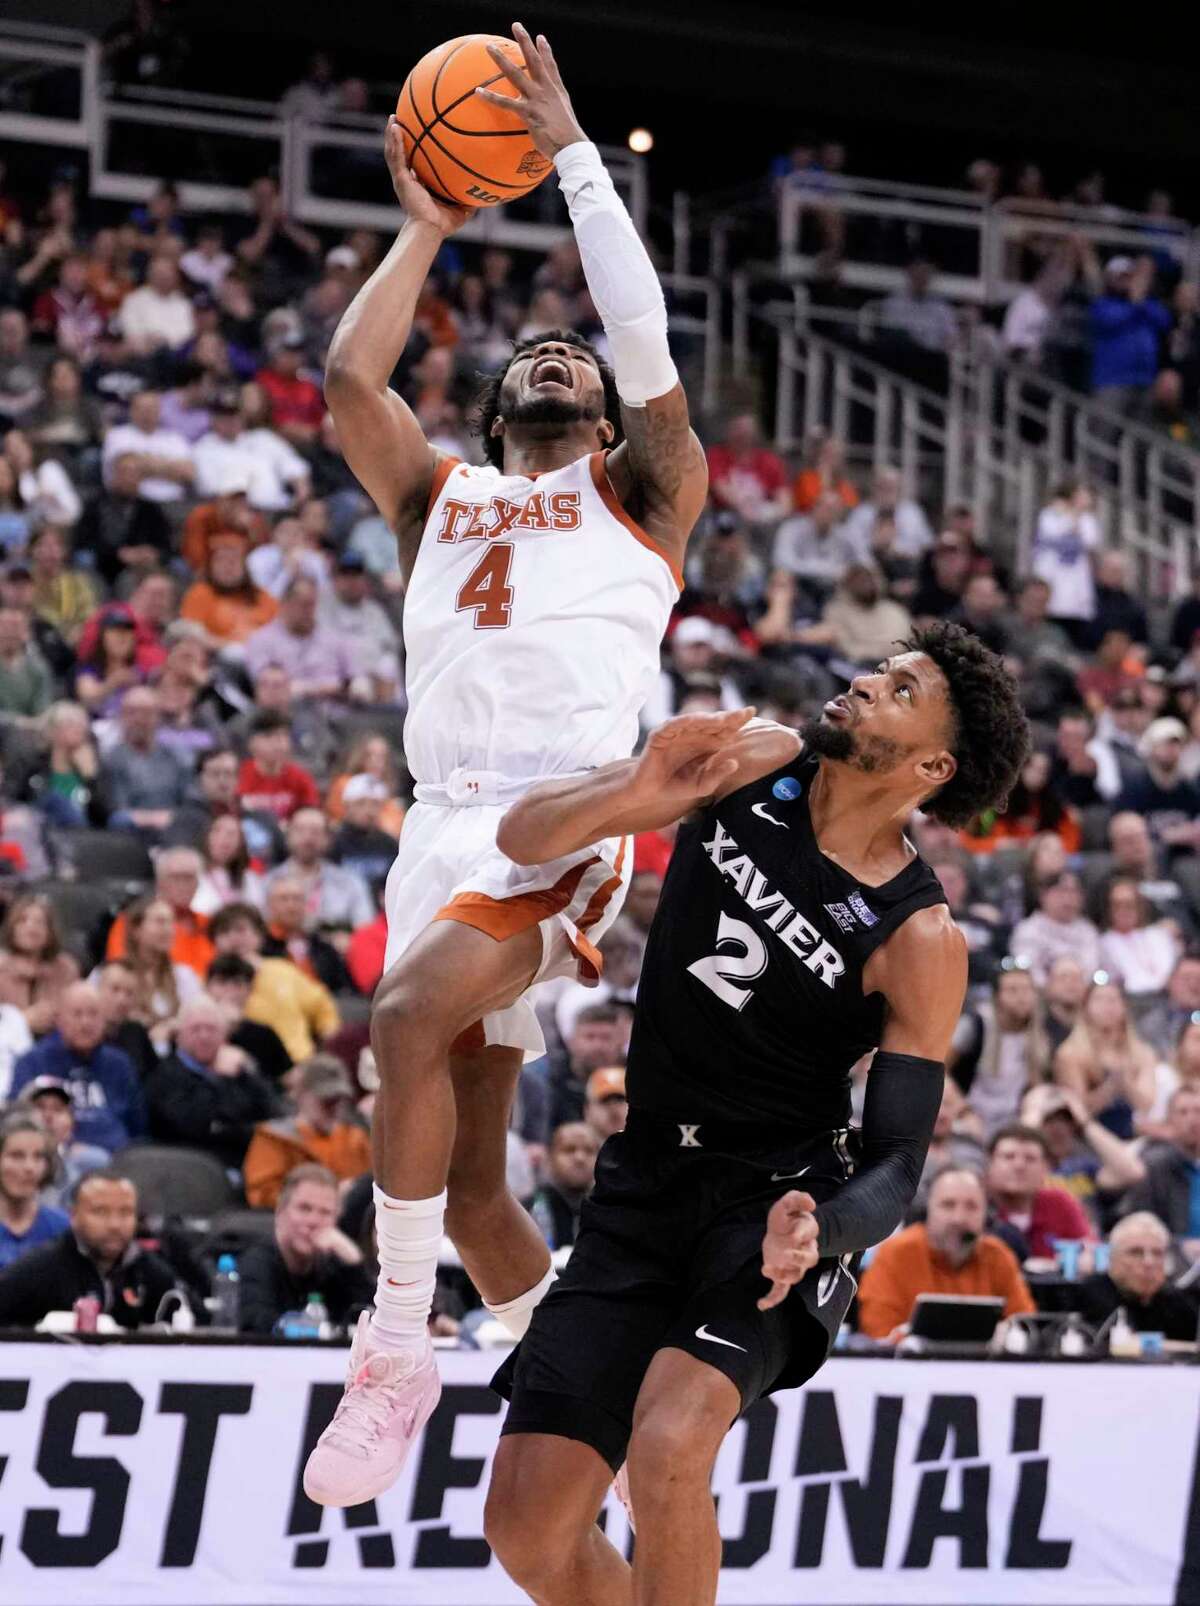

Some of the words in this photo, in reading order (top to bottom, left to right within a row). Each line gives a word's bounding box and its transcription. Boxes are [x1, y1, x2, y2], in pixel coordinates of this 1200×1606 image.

[437, 491, 582, 544] TEXAS
[455, 541, 515, 629] 4
[701, 819, 846, 989] XAVIER
[827, 903, 854, 933] EAST
[836, 903, 857, 923] BIG
[686, 910, 769, 1012] 2
[677, 1124, 703, 1147] X
[286, 1382, 1074, 1569] REONAL
